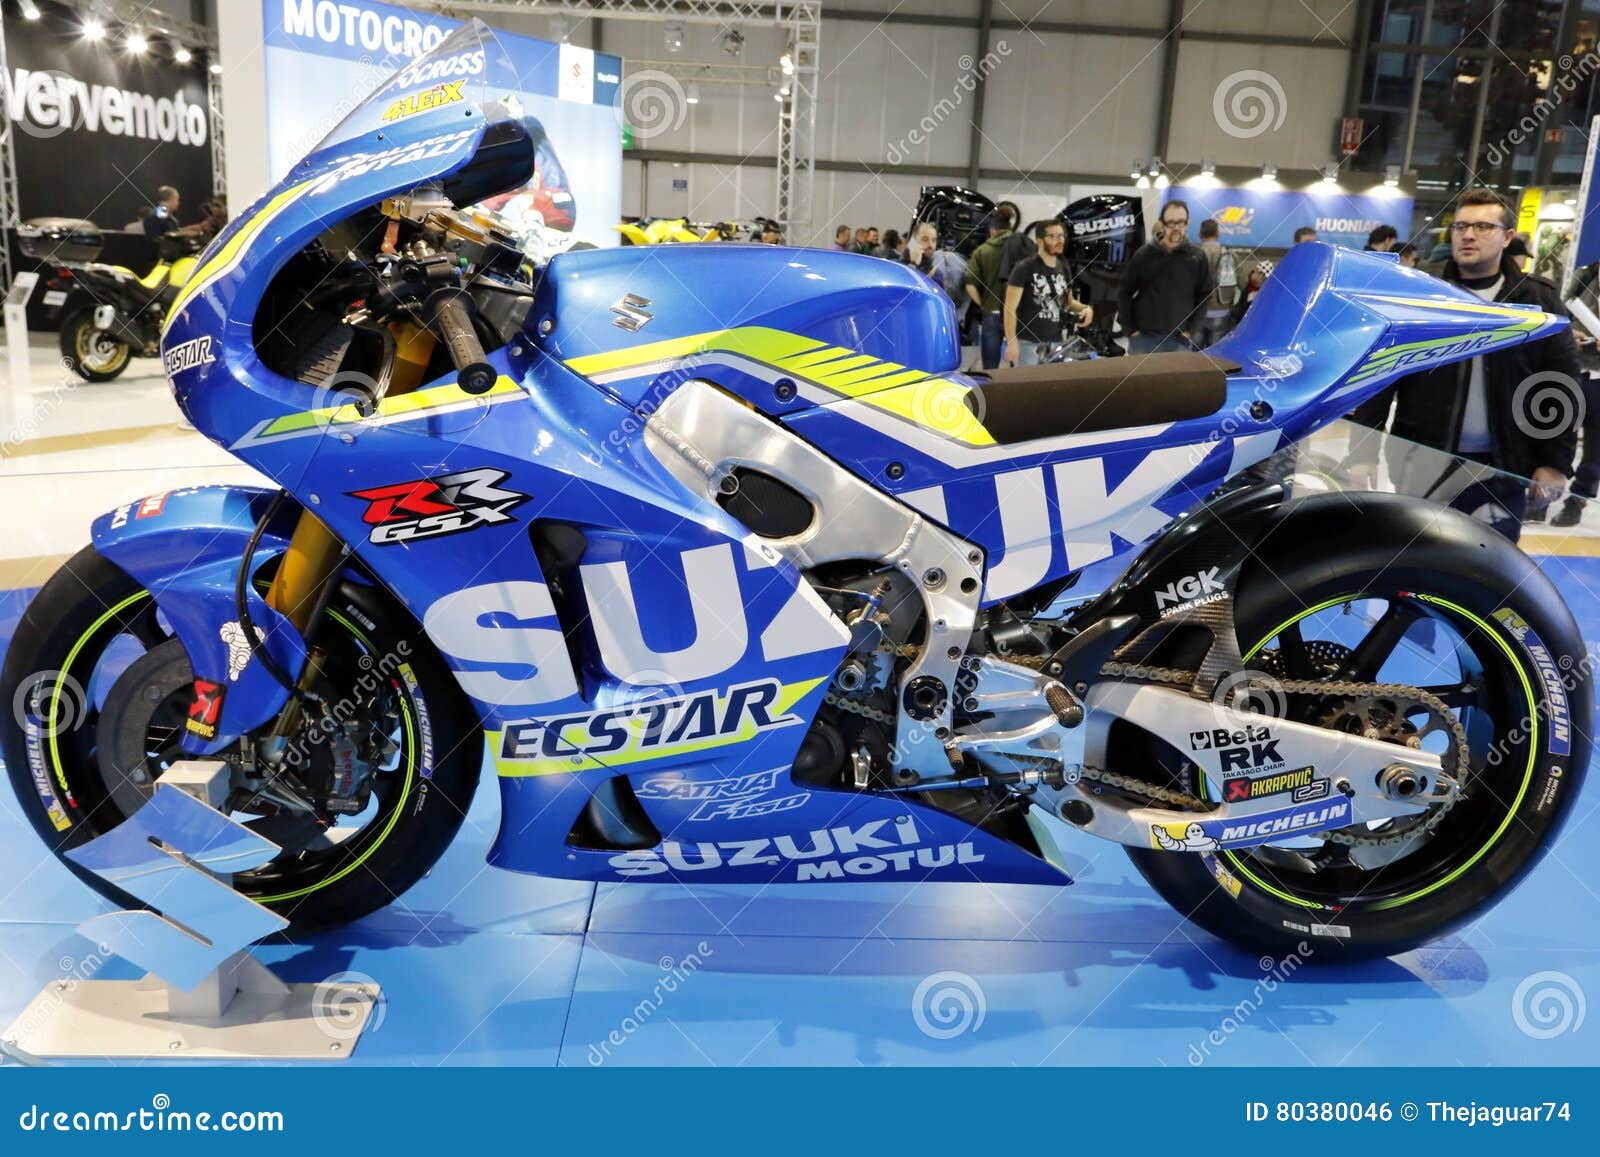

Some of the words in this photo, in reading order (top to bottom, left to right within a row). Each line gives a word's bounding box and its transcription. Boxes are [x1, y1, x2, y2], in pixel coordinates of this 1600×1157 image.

[284, 0, 455, 58] MOTOCRO
[1073, 214, 1135, 235] SUZUKI
[369, 499, 521, 544] GSX
[1154, 565, 1225, 610] NGK
[1160, 601, 1194, 618] SPARK
[1194, 590, 1229, 607] PLUGS
[1529, 645, 1569, 743] MICHELIN
[416, 697, 433, 771] MICHELIN
[496, 678, 806, 760] ECSTAR
[1212, 725, 1271, 748] Beta
[27, 723, 51, 796] MICHELIN
[1219, 739, 1284, 772] RK
[1222, 767, 1261, 779] TAKASAGO
[1263, 762, 1286, 772] CHAIN
[634, 764, 793, 800] SATRIA
[1221, 803, 1348, 840] MICHELIN
[608, 813, 920, 876] SUZUKI
[796, 841, 985, 881] MOTUL
